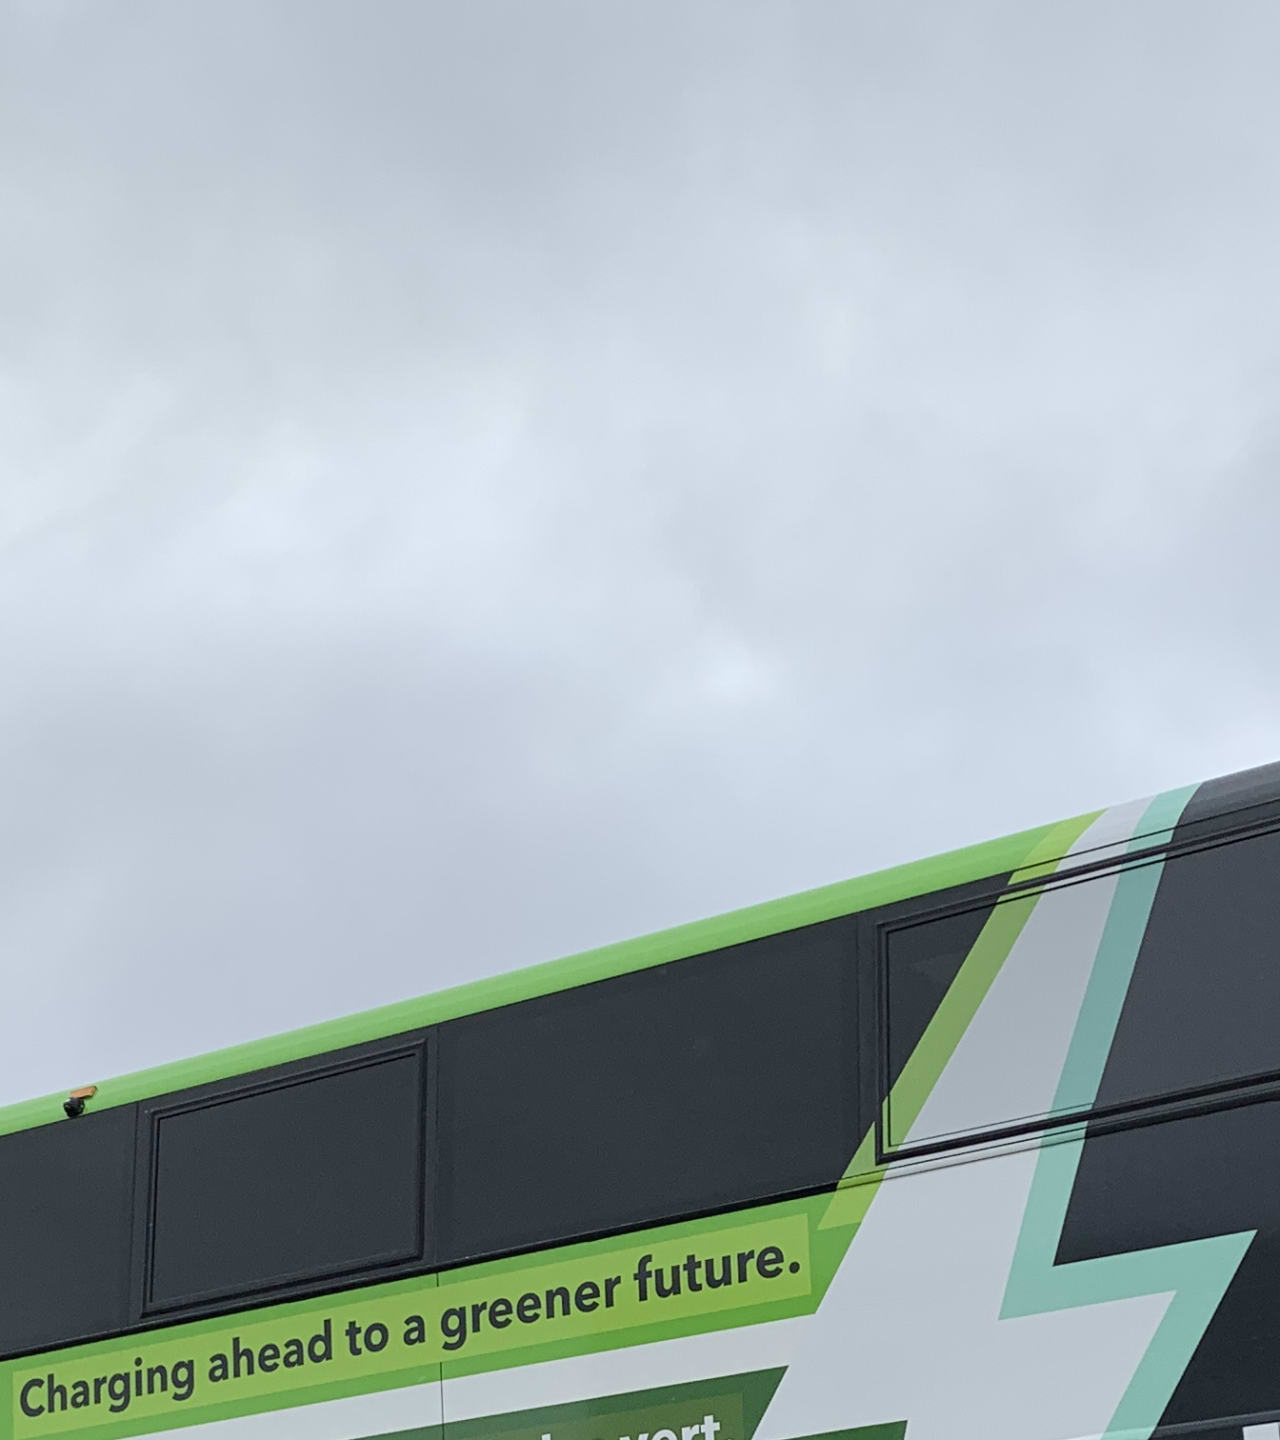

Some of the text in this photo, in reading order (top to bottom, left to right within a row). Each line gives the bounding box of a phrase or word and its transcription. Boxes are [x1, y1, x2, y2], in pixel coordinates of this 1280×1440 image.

[19, 1246, 801, 1418] Charging ahead to a greener future.
